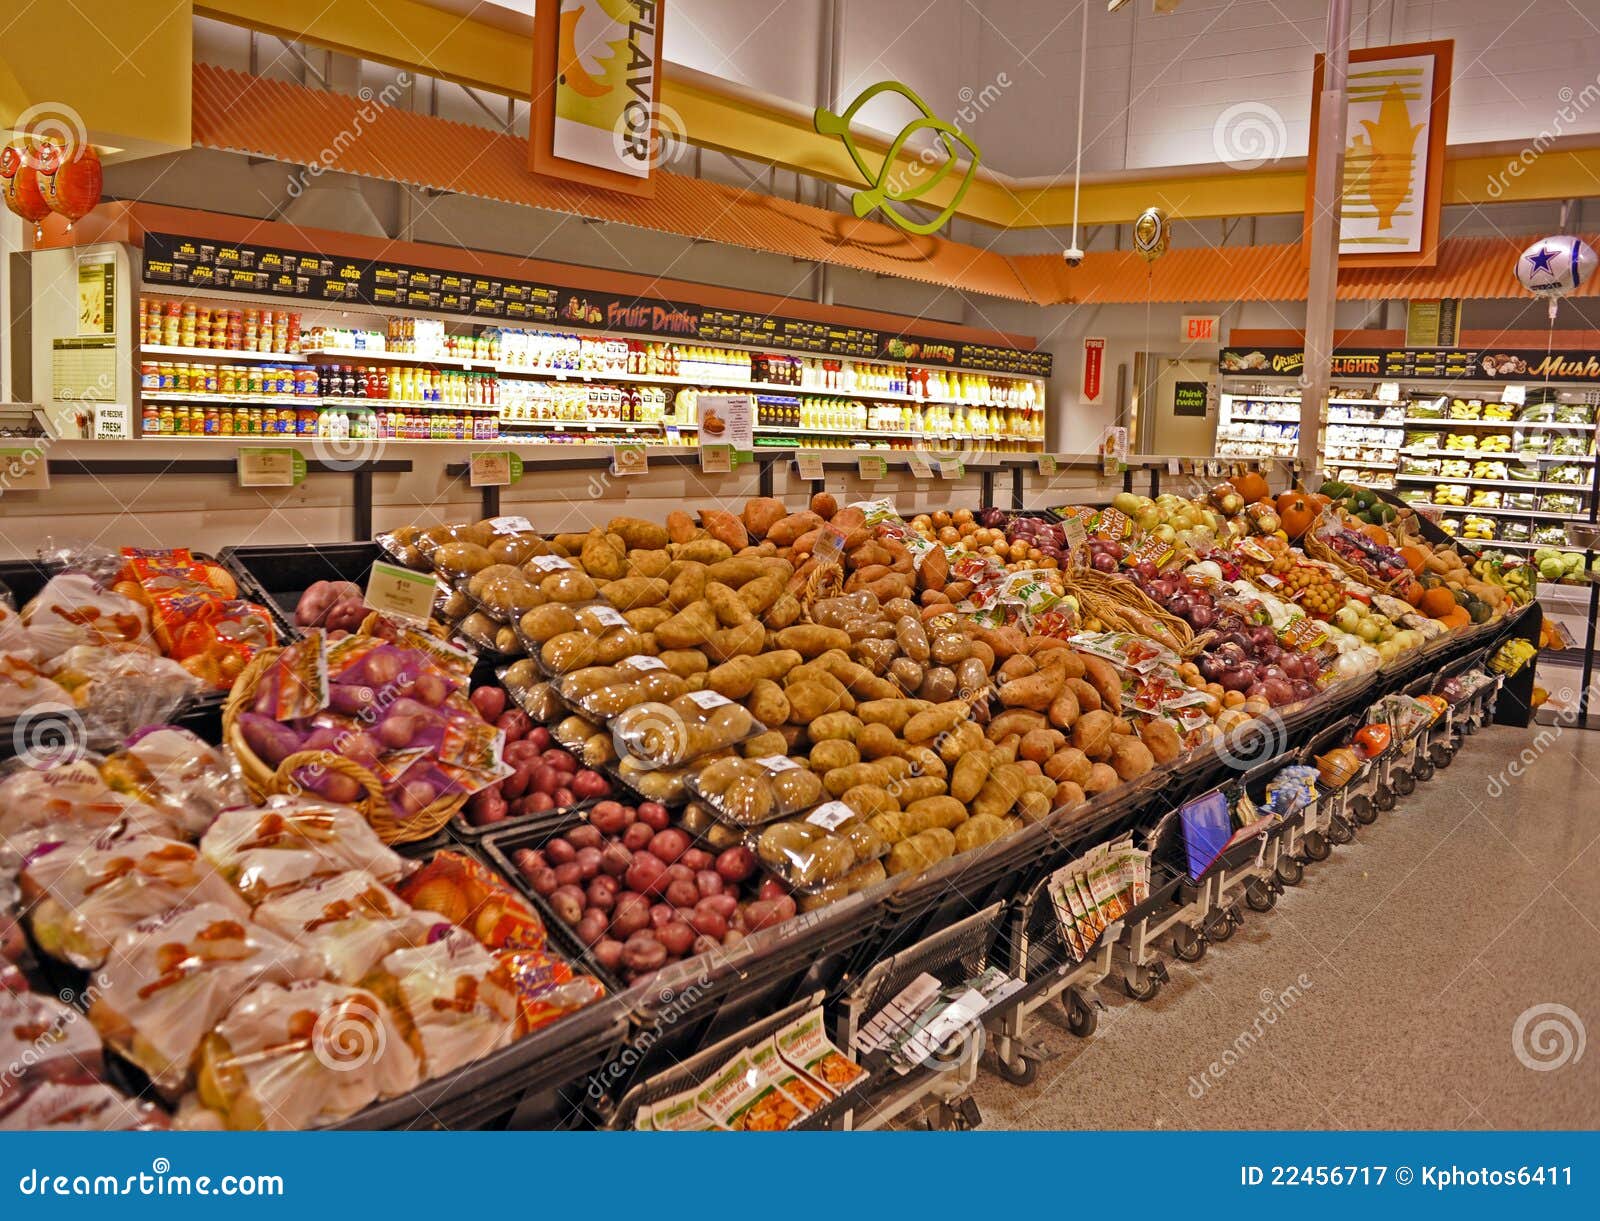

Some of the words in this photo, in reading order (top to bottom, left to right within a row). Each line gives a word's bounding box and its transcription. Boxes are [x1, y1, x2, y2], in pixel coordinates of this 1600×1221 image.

[622, 0, 655, 162] FLAVOR
[340, 269, 360, 280] CIDER
[607, 301, 652, 328] Fruit
[652, 306, 698, 334] Drinks
[1188, 319, 1214, 339] EXIT
[1086, 340, 1104, 349] FIRE
[920, 344, 956, 363] JUICES
[1329, 359, 1380, 374] ELIGHTS
[1528, 356, 1600, 377] Mush
[1178, 389, 1204, 398] Think
[1176, 398, 1204, 408] twice!
[102, 421, 121, 432] FRESH
